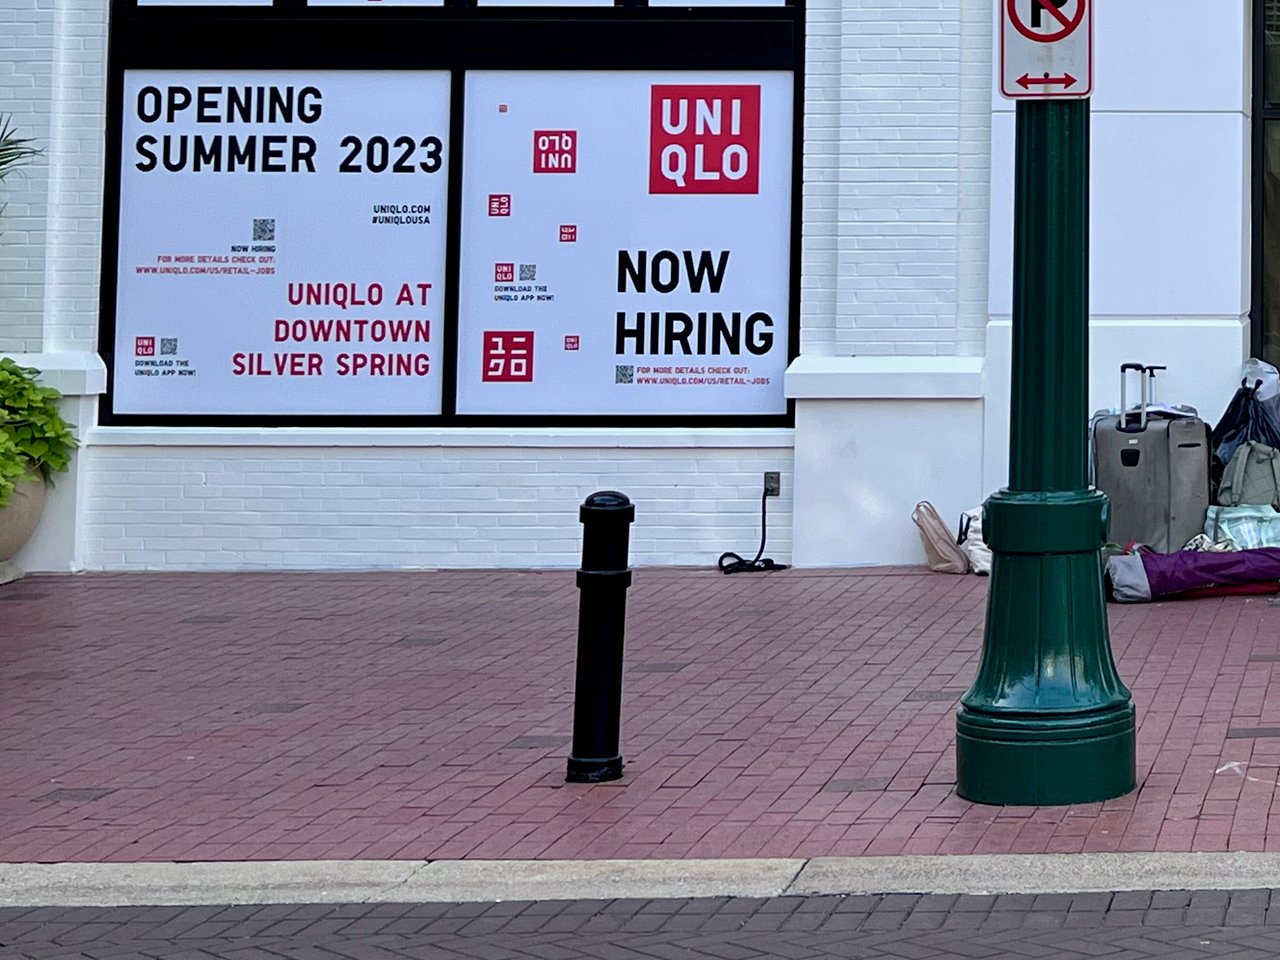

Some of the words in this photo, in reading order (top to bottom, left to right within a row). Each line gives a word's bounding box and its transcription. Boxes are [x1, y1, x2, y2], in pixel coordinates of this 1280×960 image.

[136, 86, 322, 124] OPENING
[661, 98, 741, 135] UNI
[538, 132, 572, 151] QLO
[135, 134, 317, 173] SUMMER
[339, 135, 443, 173] 2023
[541, 153, 572, 168] UNI
[660, 144, 748, 187] QLO
[373, 204, 431, 214] UNIQLO.COM
[372, 216, 431, 225] #UNIQLOUSA
[157, 255, 172, 263] FOR
[175, 255, 194, 263] MORE
[135, 267, 275, 276] WWW.UNIQLO.COM/US/RETAIL-JOBS
[616, 249, 731, 293] NOW
[287, 282, 383, 309] UNIQLO
[396, 283, 432, 306] AT
[274, 319, 430, 343] DOWNTOWN
[615, 311, 774, 356] HIRING
[489, 337, 527, 354] ユニ
[232, 352, 323, 376] SILVER
[336, 352, 430, 376] SPRING
[488, 358, 527, 376] クロ
[636, 377, 770, 385] WWW.UNIQLO.COM/US/RETAIL-JOBS
